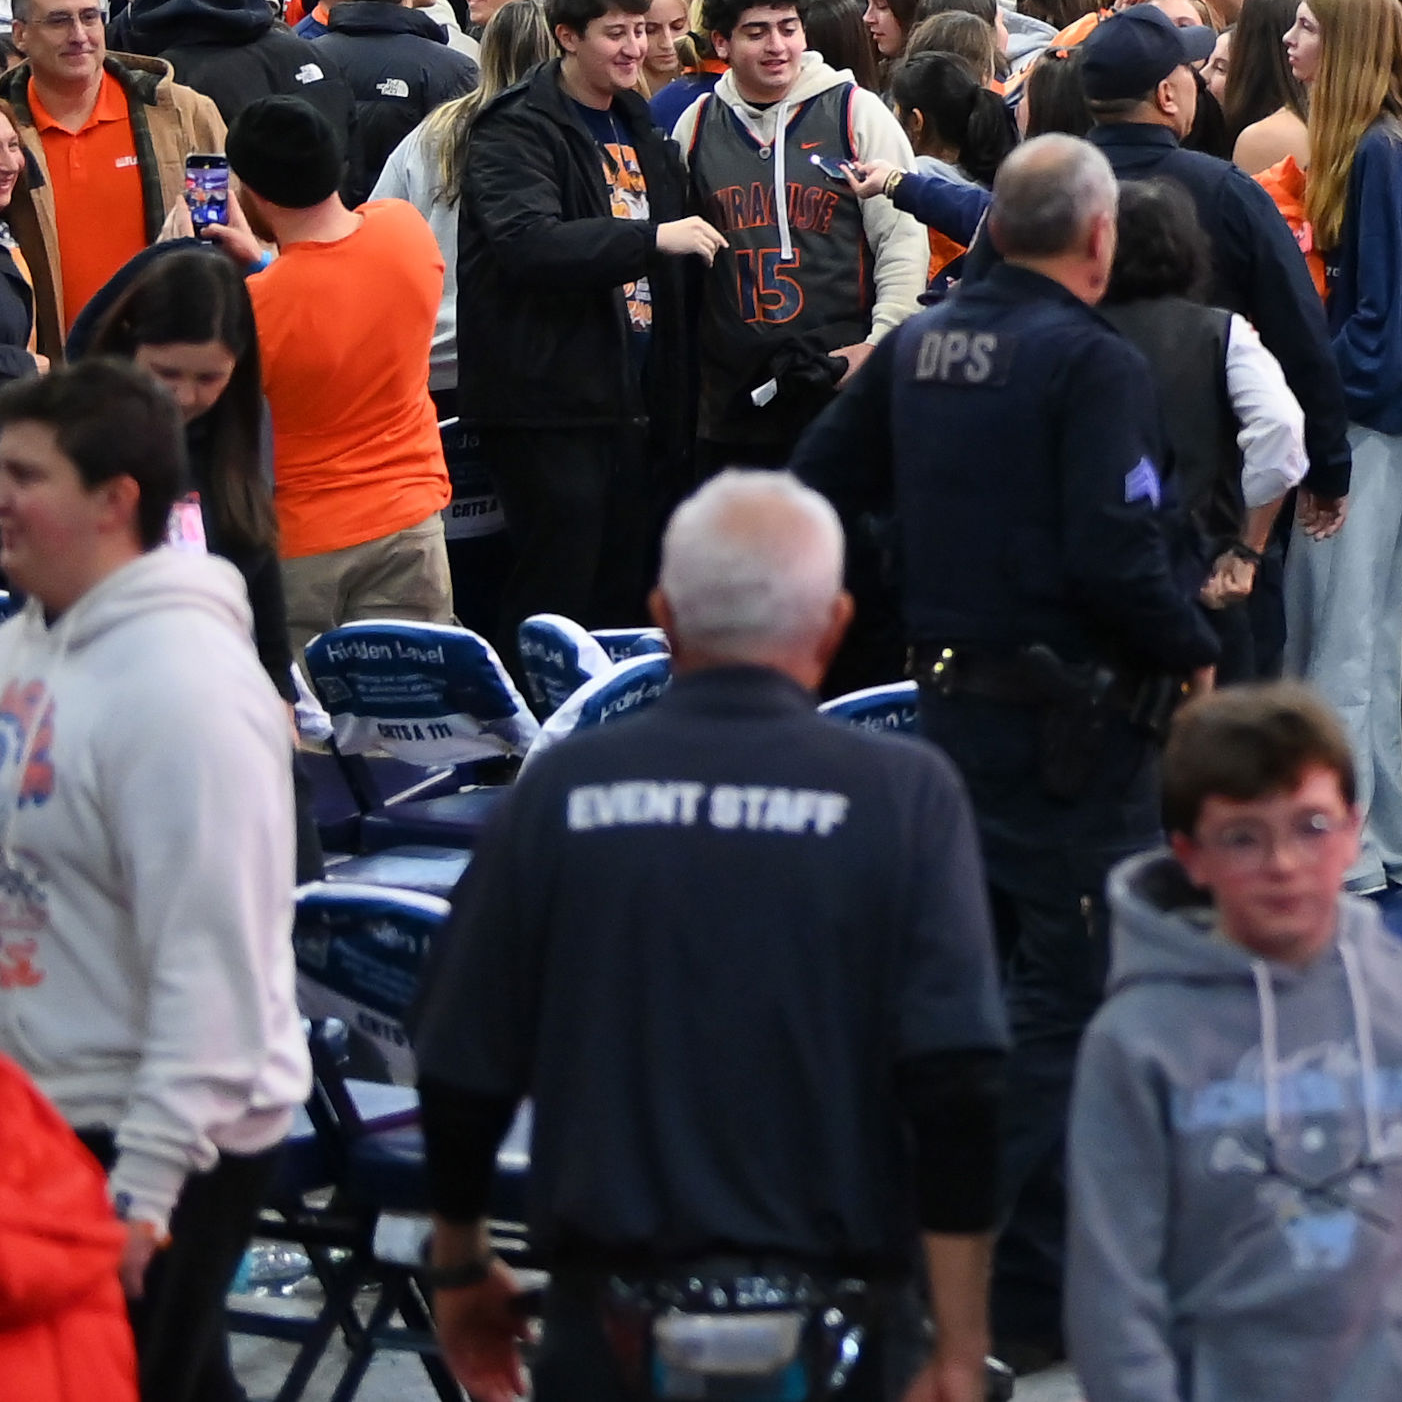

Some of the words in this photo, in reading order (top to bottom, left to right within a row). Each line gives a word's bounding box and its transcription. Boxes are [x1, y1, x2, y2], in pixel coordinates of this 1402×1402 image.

[735, 248, 806, 324] 15
[915, 330, 998, 382] DPS
[567, 781, 701, 833] EVENT
[709, 784, 854, 837] STAFF
